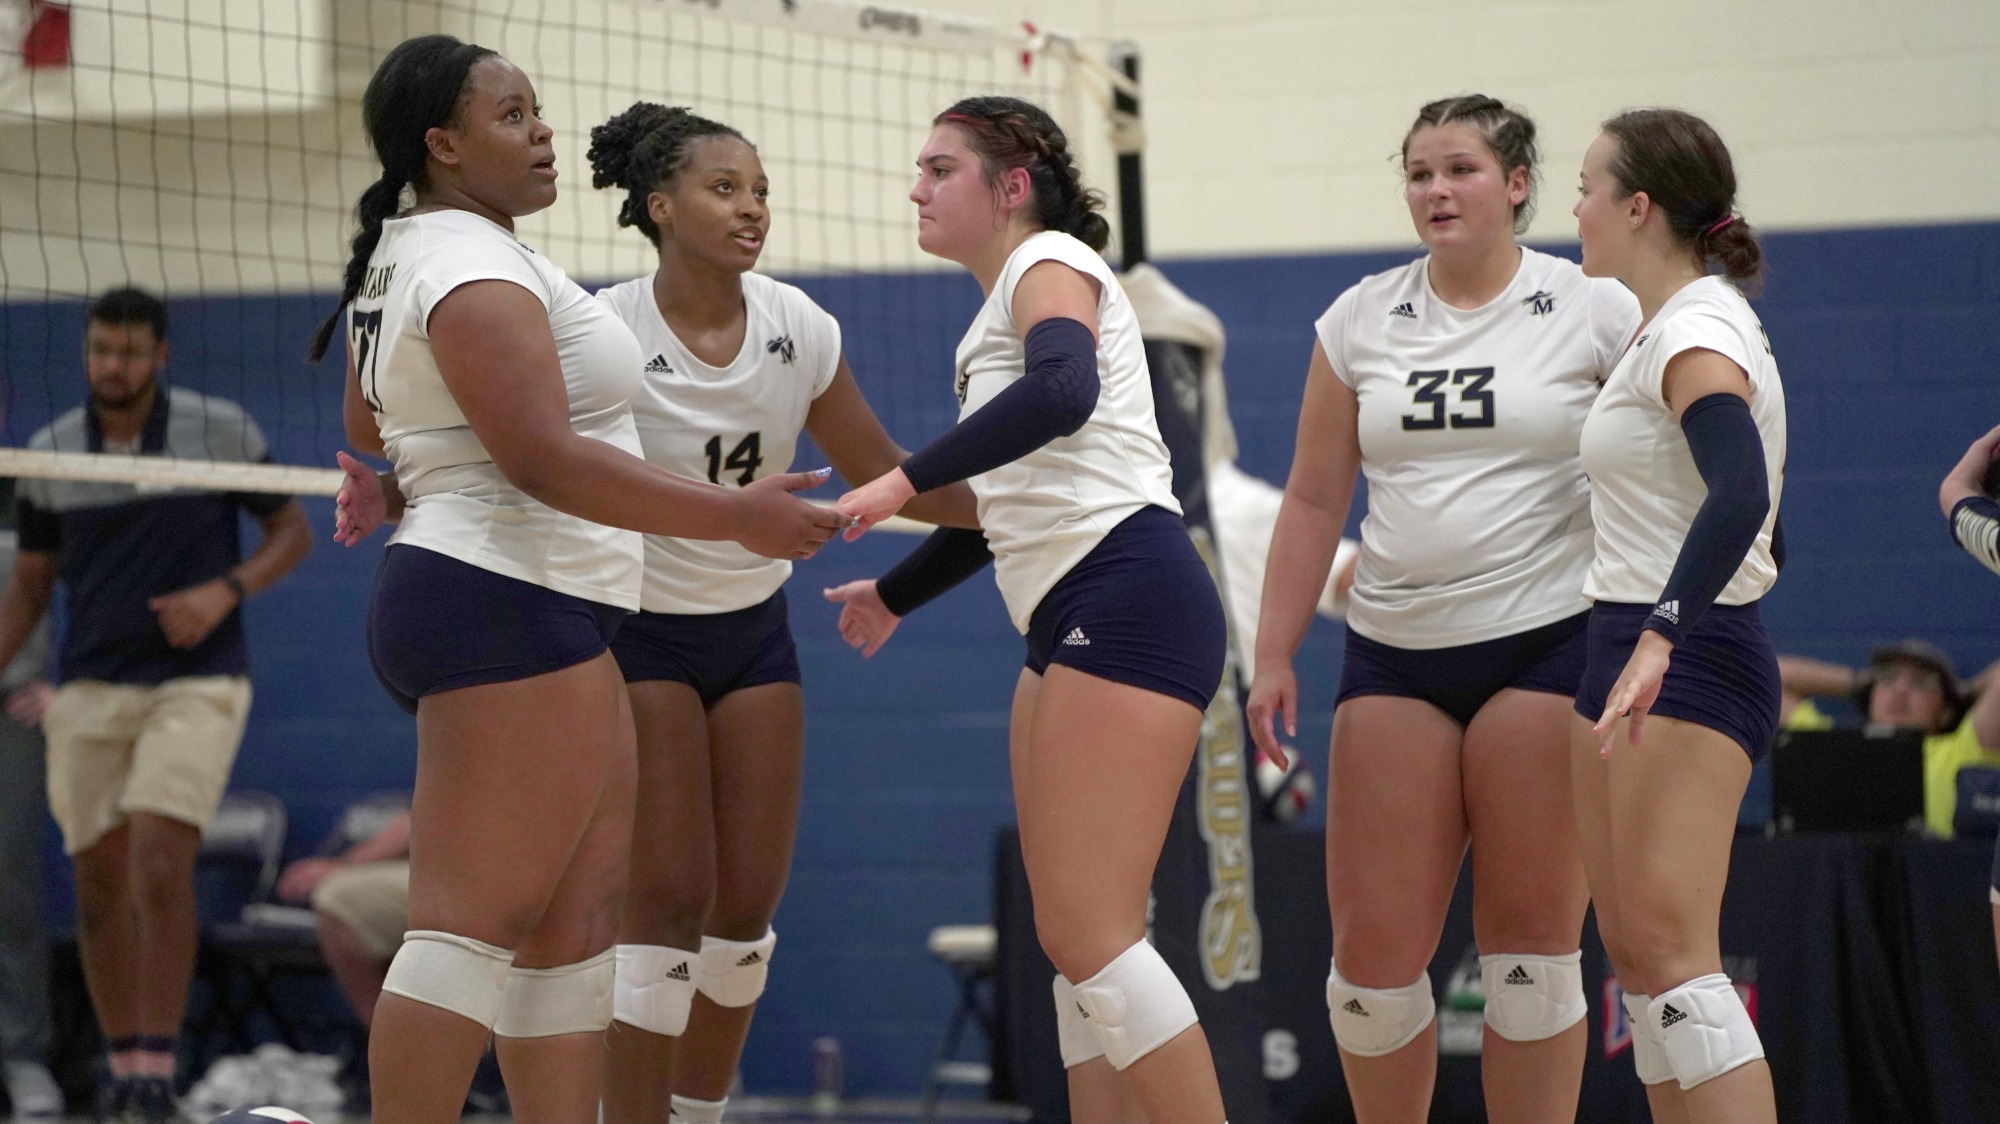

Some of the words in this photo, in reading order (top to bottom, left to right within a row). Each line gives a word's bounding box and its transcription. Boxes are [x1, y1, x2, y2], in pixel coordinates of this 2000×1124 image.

[1528, 297, 1559, 318] M
[1401, 366, 1495, 431] 33
[704, 431, 763, 487] 14
[1653, 608, 1680, 625] adidas
[1504, 976, 1535, 985] adidas
[1661, 1011, 1688, 1029] adidas
